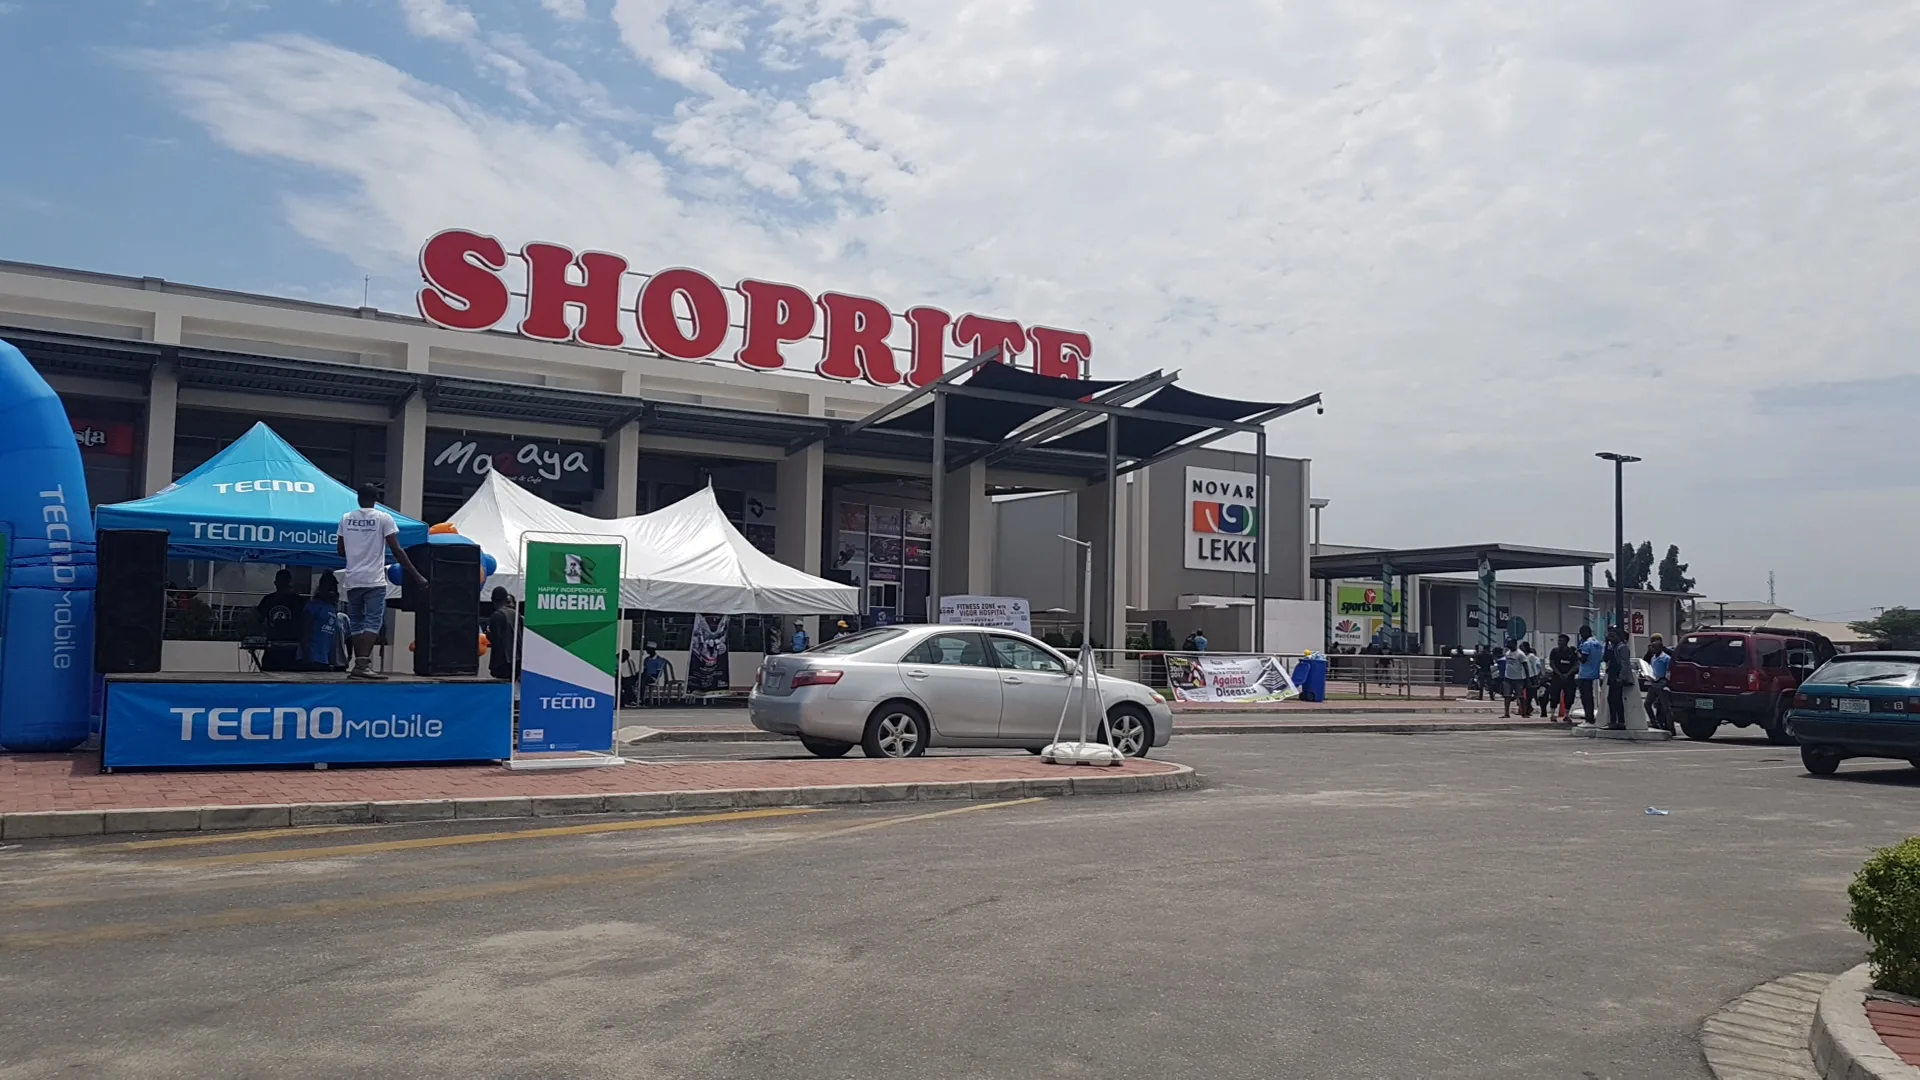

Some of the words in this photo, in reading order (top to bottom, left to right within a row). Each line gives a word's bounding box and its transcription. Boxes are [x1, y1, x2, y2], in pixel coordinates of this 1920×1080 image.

[417, 228, 1092, 388] SHOPRITE
[75, 426, 106, 446] sta
[433, 441, 589, 480] Mazaya
[212, 480, 316, 494] TECNO
[1192, 479, 1254, 499] NOVAR
[189, 521, 275, 542] TECNO
[346, 519, 376, 527] TECNO
[39, 484, 76, 584] TECNO
[537, 593, 606, 611] NIGERIA
[956, 603, 980, 611] FITNESS
[979, 609, 1007, 617] HOSPITAL
[1213, 675, 1246, 687] Against
[1216, 686, 1257, 697] Diseases
[539, 696, 596, 709] TECNO
[170, 706, 343, 741] TECNO
